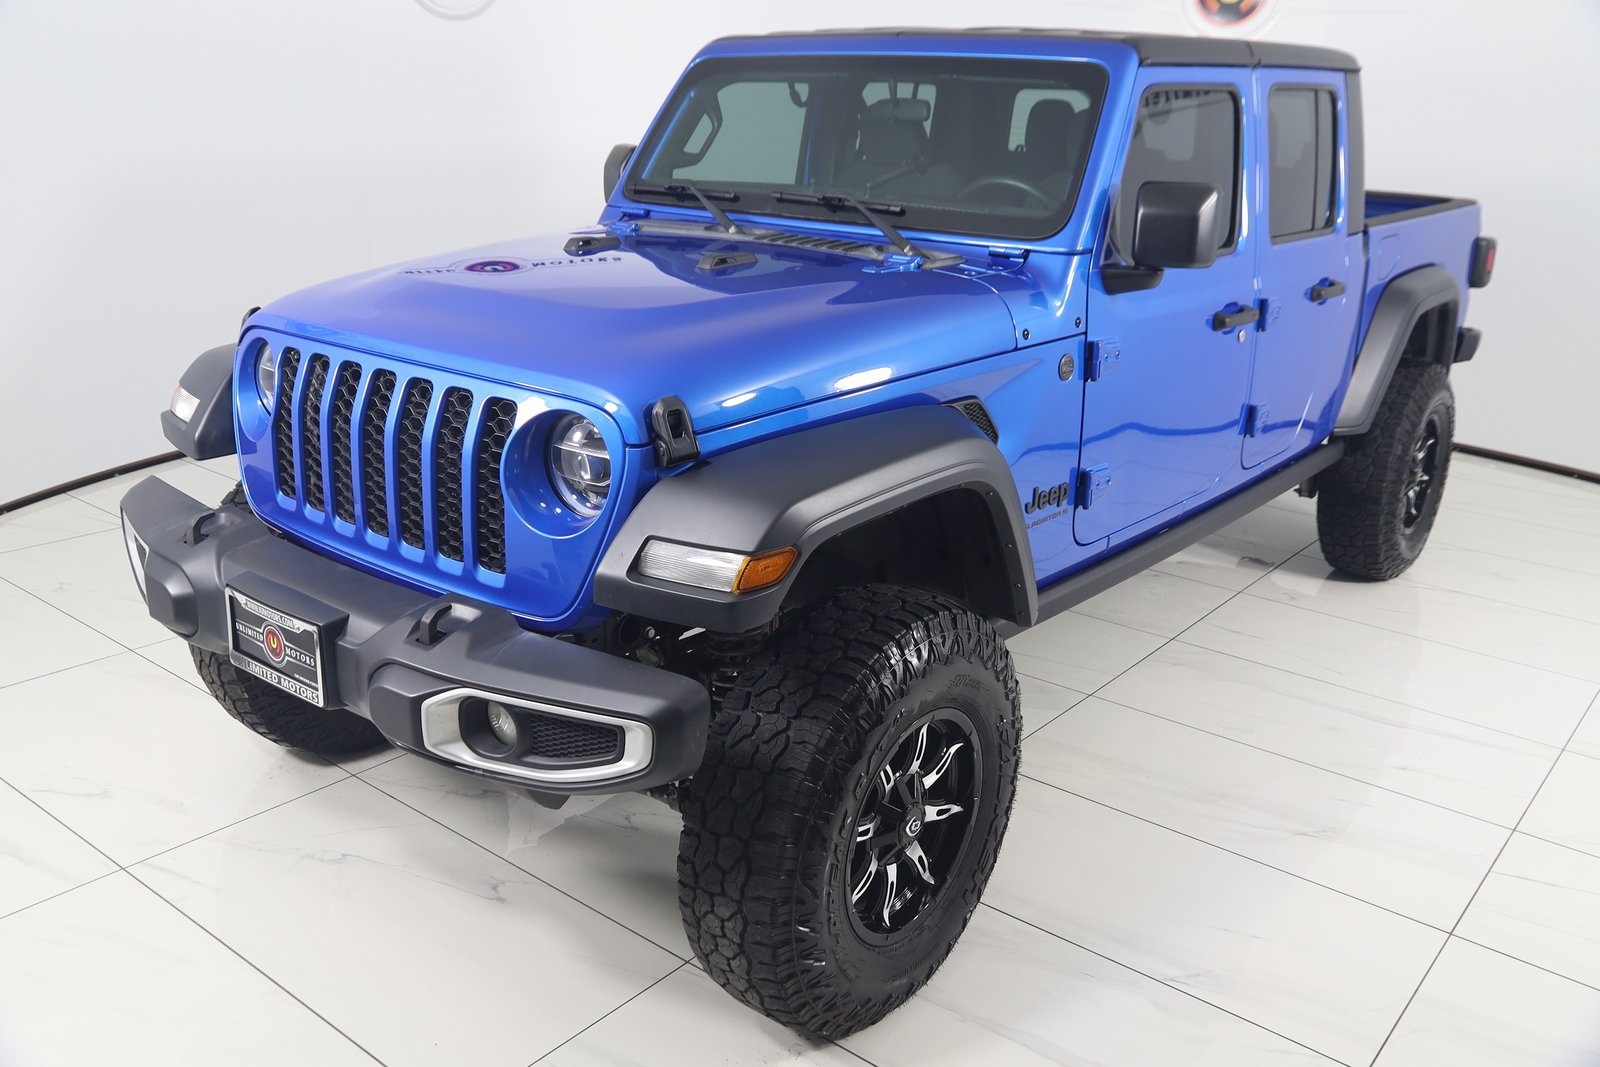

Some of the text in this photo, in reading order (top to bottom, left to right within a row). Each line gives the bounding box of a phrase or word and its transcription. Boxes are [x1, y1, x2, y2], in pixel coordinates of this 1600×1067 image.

[1025, 482, 1069, 514] Jeep
[1026, 510, 1062, 529] LADIATOR
[235, 621, 316, 667] UNLIMITED MOTORS
[280, 676, 318, 703] MOTORS
